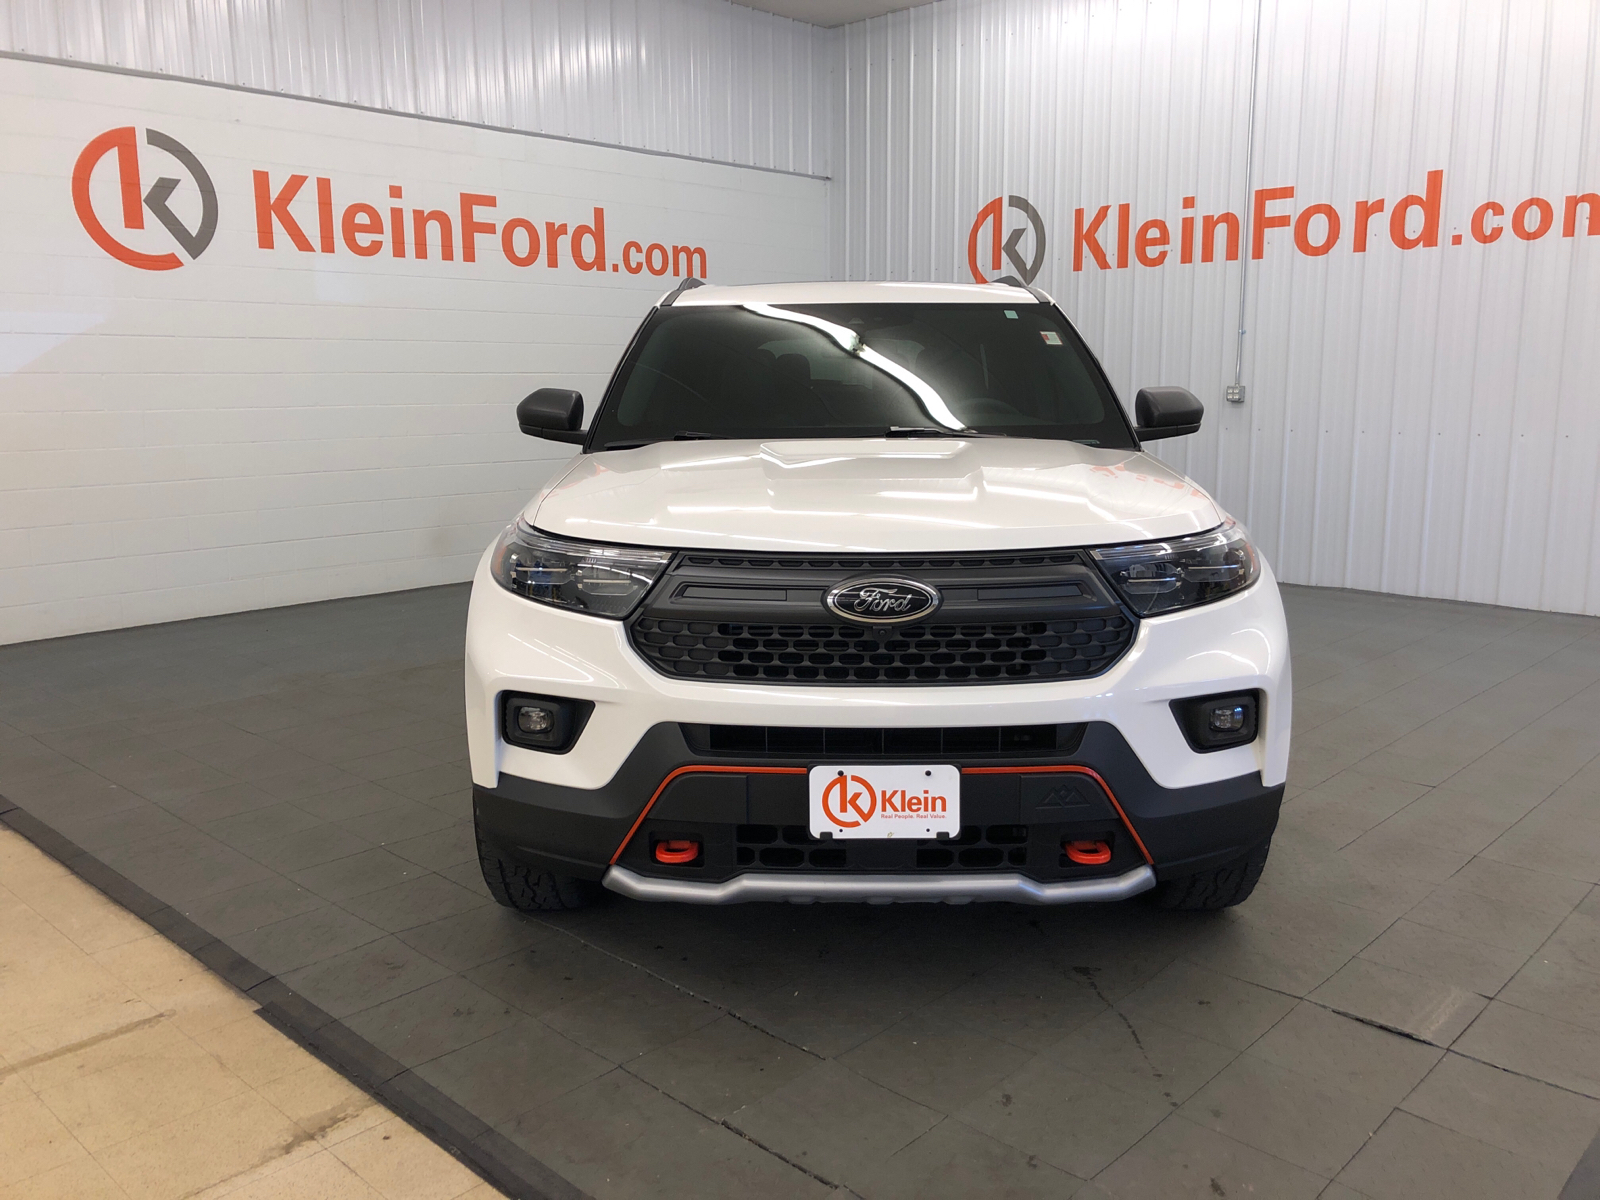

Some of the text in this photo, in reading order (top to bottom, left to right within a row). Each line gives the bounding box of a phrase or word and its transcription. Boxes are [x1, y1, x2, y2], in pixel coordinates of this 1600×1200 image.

[252, 170, 707, 279] KleinFord.com
[849, 587, 916, 612] Ford
[881, 790, 947, 813] Klein
